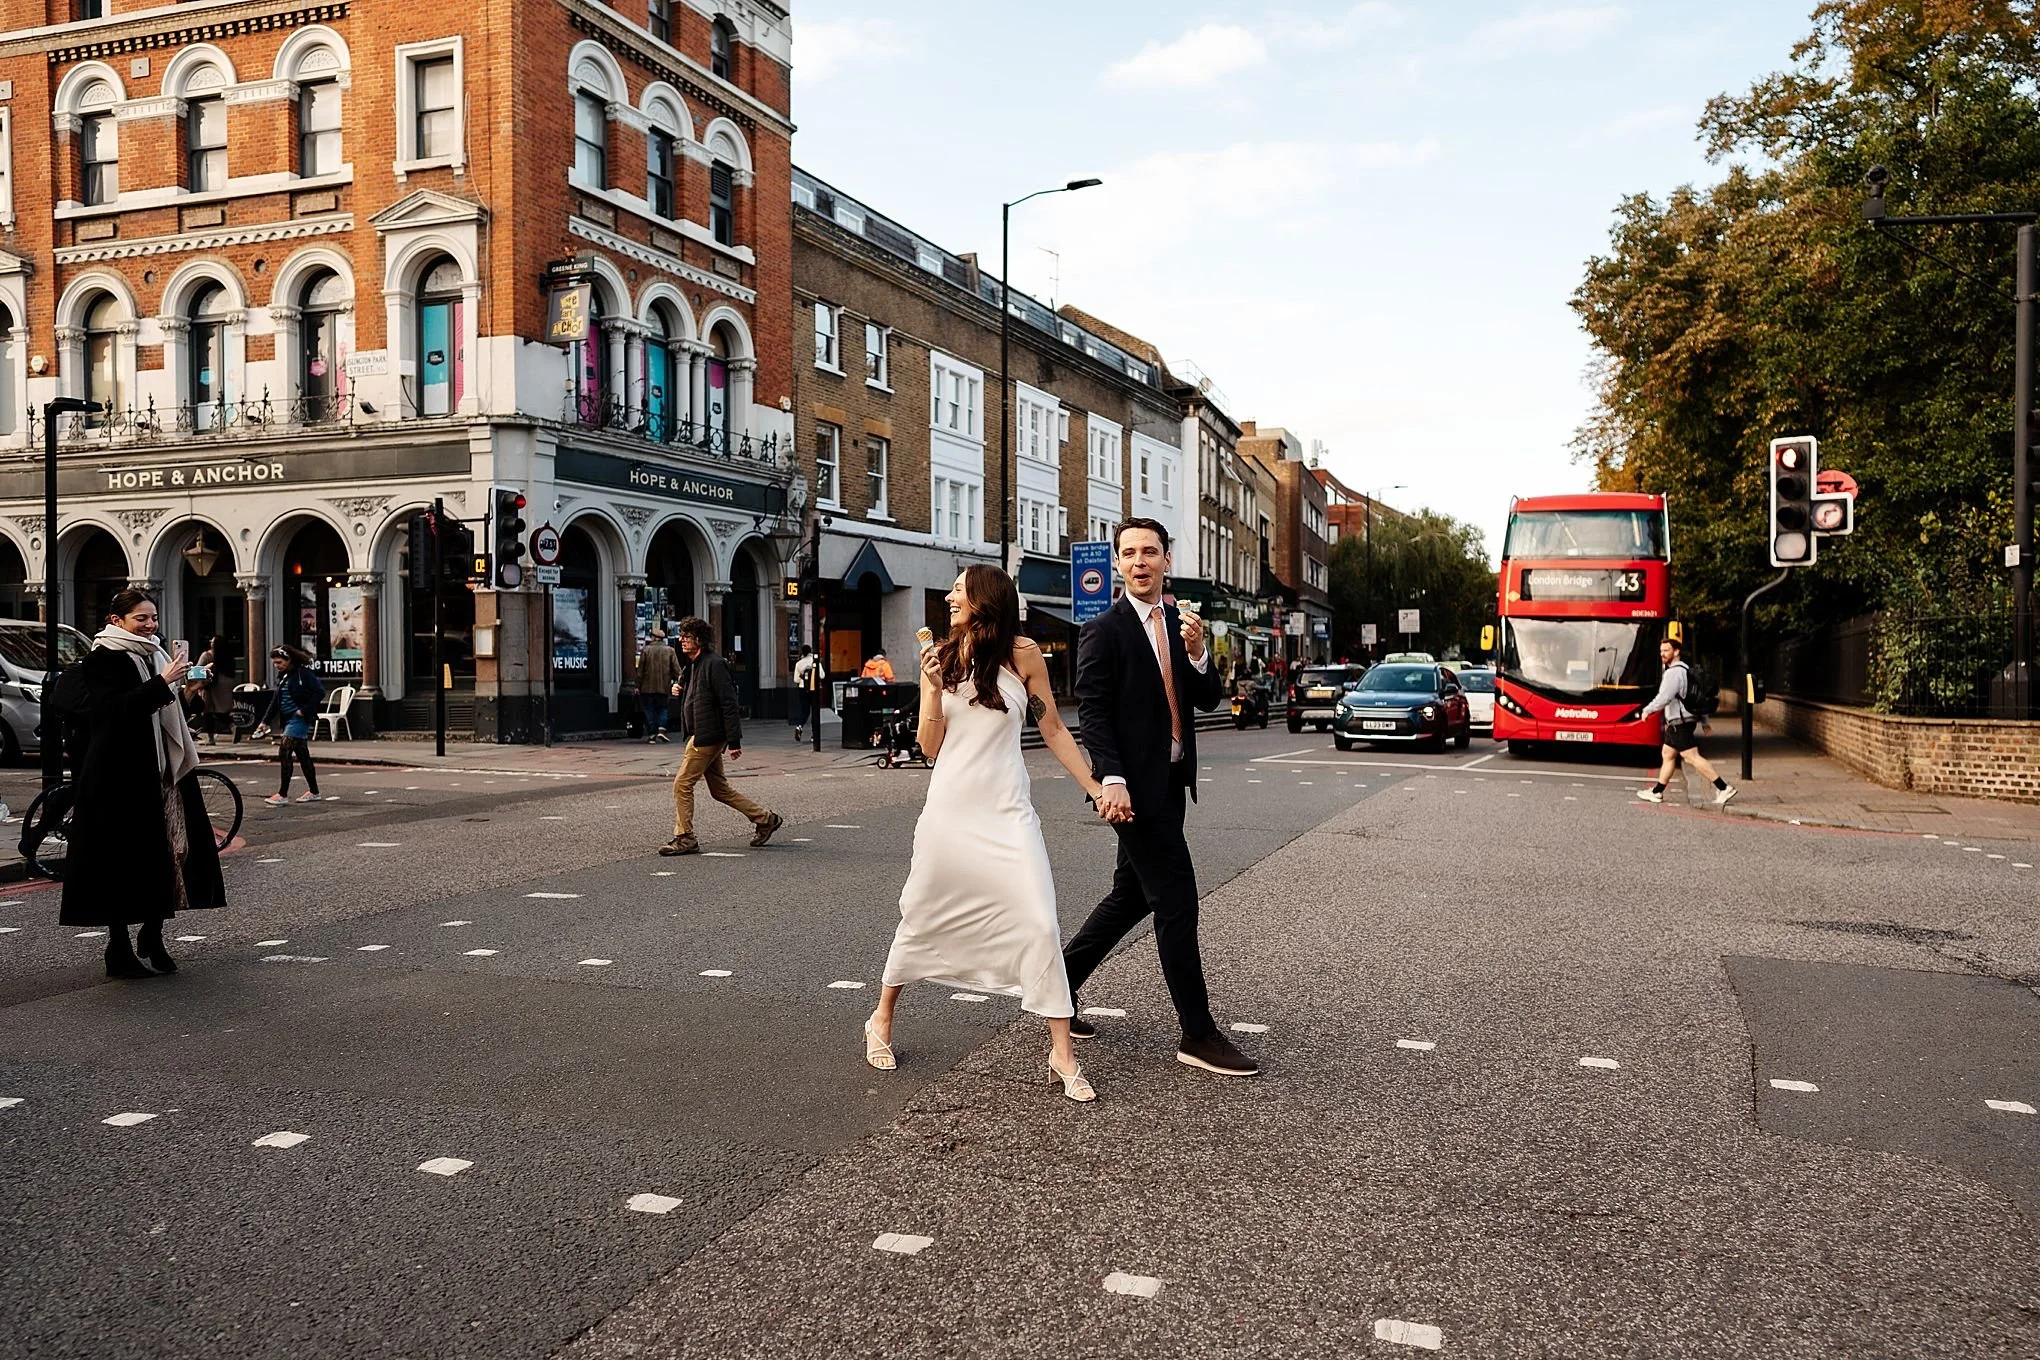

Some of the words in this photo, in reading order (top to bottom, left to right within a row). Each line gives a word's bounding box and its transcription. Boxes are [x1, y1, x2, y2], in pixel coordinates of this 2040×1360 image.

[373, 355, 386, 363] PARK
[350, 365, 373, 375] STREET
[108, 470, 164, 489] HOPE
[171, 470, 184, 485] &
[192, 463, 284, 484] ANCHOR
[630, 470, 667, 489] HOPE
[670, 478, 679, 490] &
[682, 480, 733, 500] ANCHOR
[1528, 574, 1561, 585] London
[1562, 574, 1593, 587] Bridge
[1614, 573, 1640, 592] 43
[787, 582, 798, 595] 05
[323, 660, 363, 673] THEATR
[564, 656, 588, 669] MUSIC
[1555, 707, 1599, 720] Metroline
